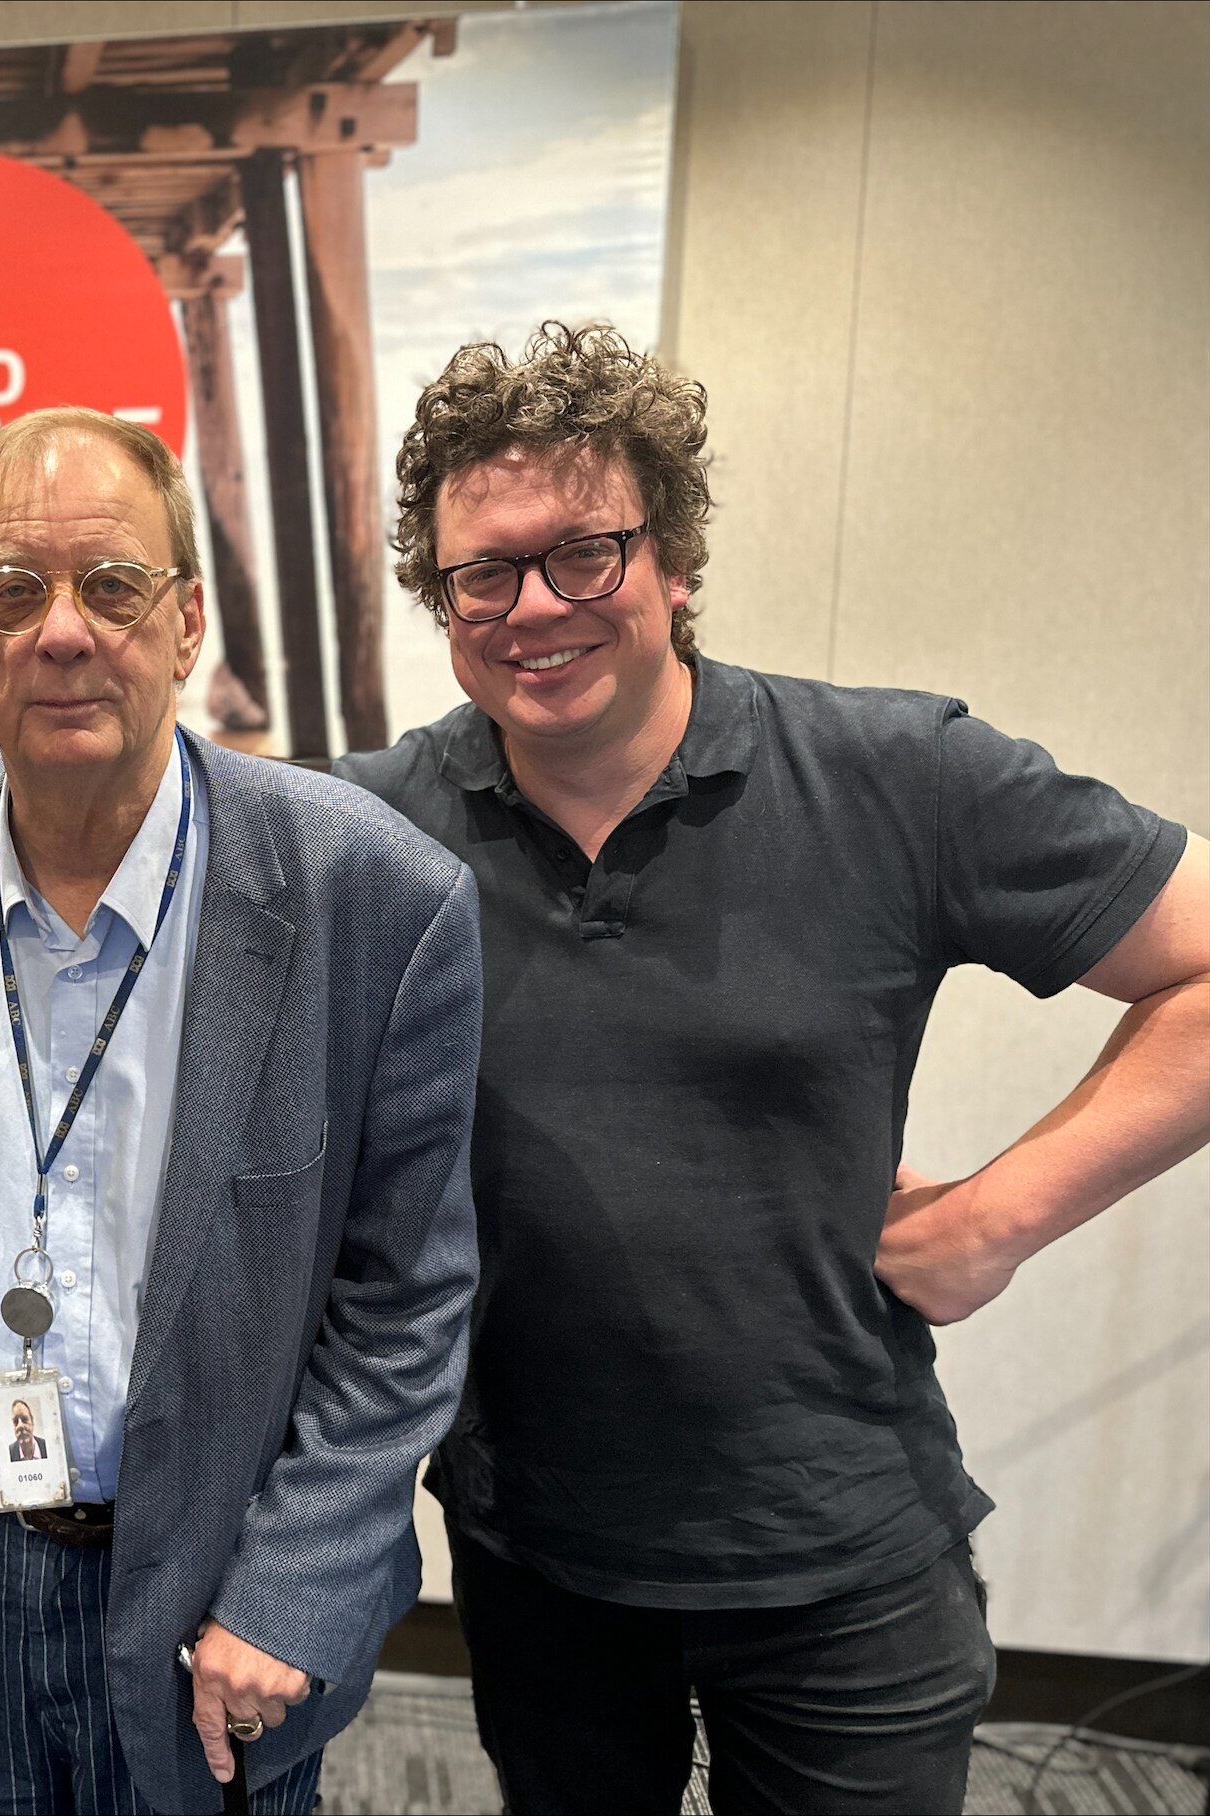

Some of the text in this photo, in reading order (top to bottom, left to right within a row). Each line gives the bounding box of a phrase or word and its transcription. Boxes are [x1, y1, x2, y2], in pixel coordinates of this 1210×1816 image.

[8, 1001, 21, 1026] ABC
[104, 1005, 120, 1032] ABC
[69, 1088, 83, 1114] ABC
[18, 1472, 43, 1483] 01060
